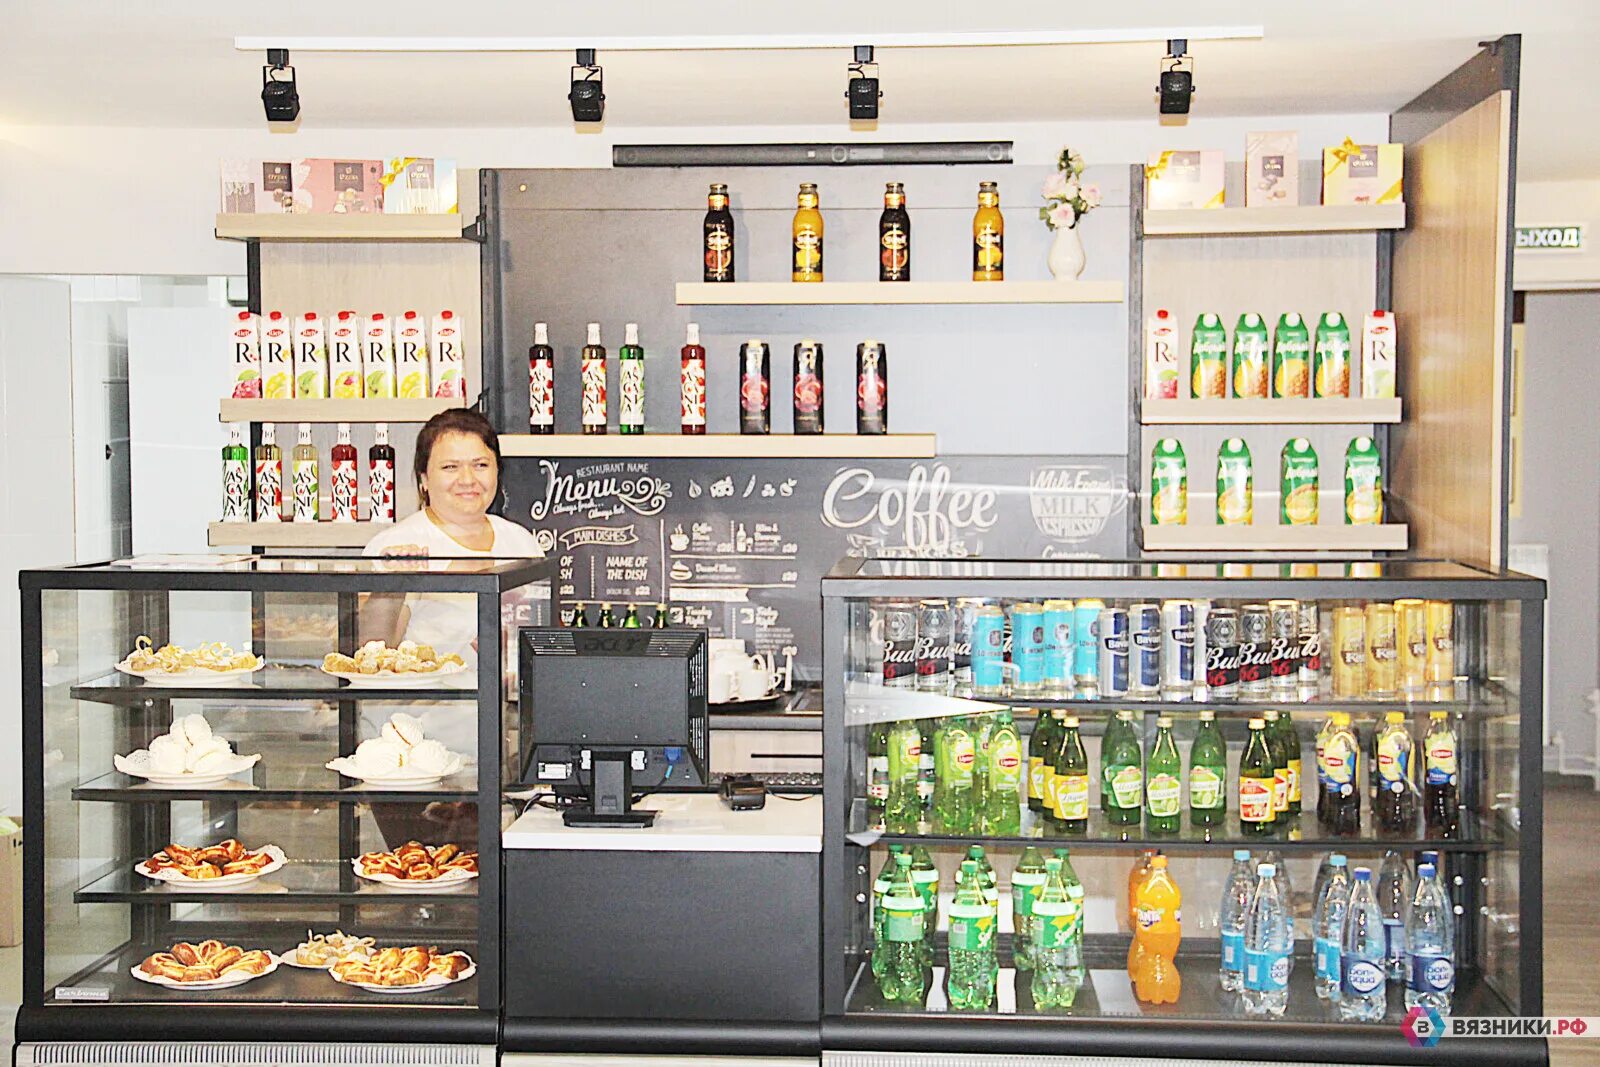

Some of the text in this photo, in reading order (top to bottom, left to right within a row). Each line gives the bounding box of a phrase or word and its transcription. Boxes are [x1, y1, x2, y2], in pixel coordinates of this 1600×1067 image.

[1516, 228, 1579, 248] ЫХОД
[236, 342, 252, 363] R
[268, 342, 284, 363] R
[302, 342, 317, 362] R
[336, 342, 352, 362] R
[370, 342, 385, 362] R
[403, 342, 419, 362] R
[440, 342, 455, 362] R
[1155, 342, 1170, 362] R
[1372, 340, 1387, 361] R
[576, 463, 650, 479] RESTAURANT NAME
[1034, 469, 1071, 490] Milk
[821, 462, 1000, 557] Coffee
[1040, 497, 1101, 516] MILK
[573, 530, 628, 543] MAIN DISHES
[560, 556, 574, 568] OF
[606, 556, 649, 568] NAME OF
[559, 569, 573, 581] SH
[606, 569, 648, 581] THE DISH
